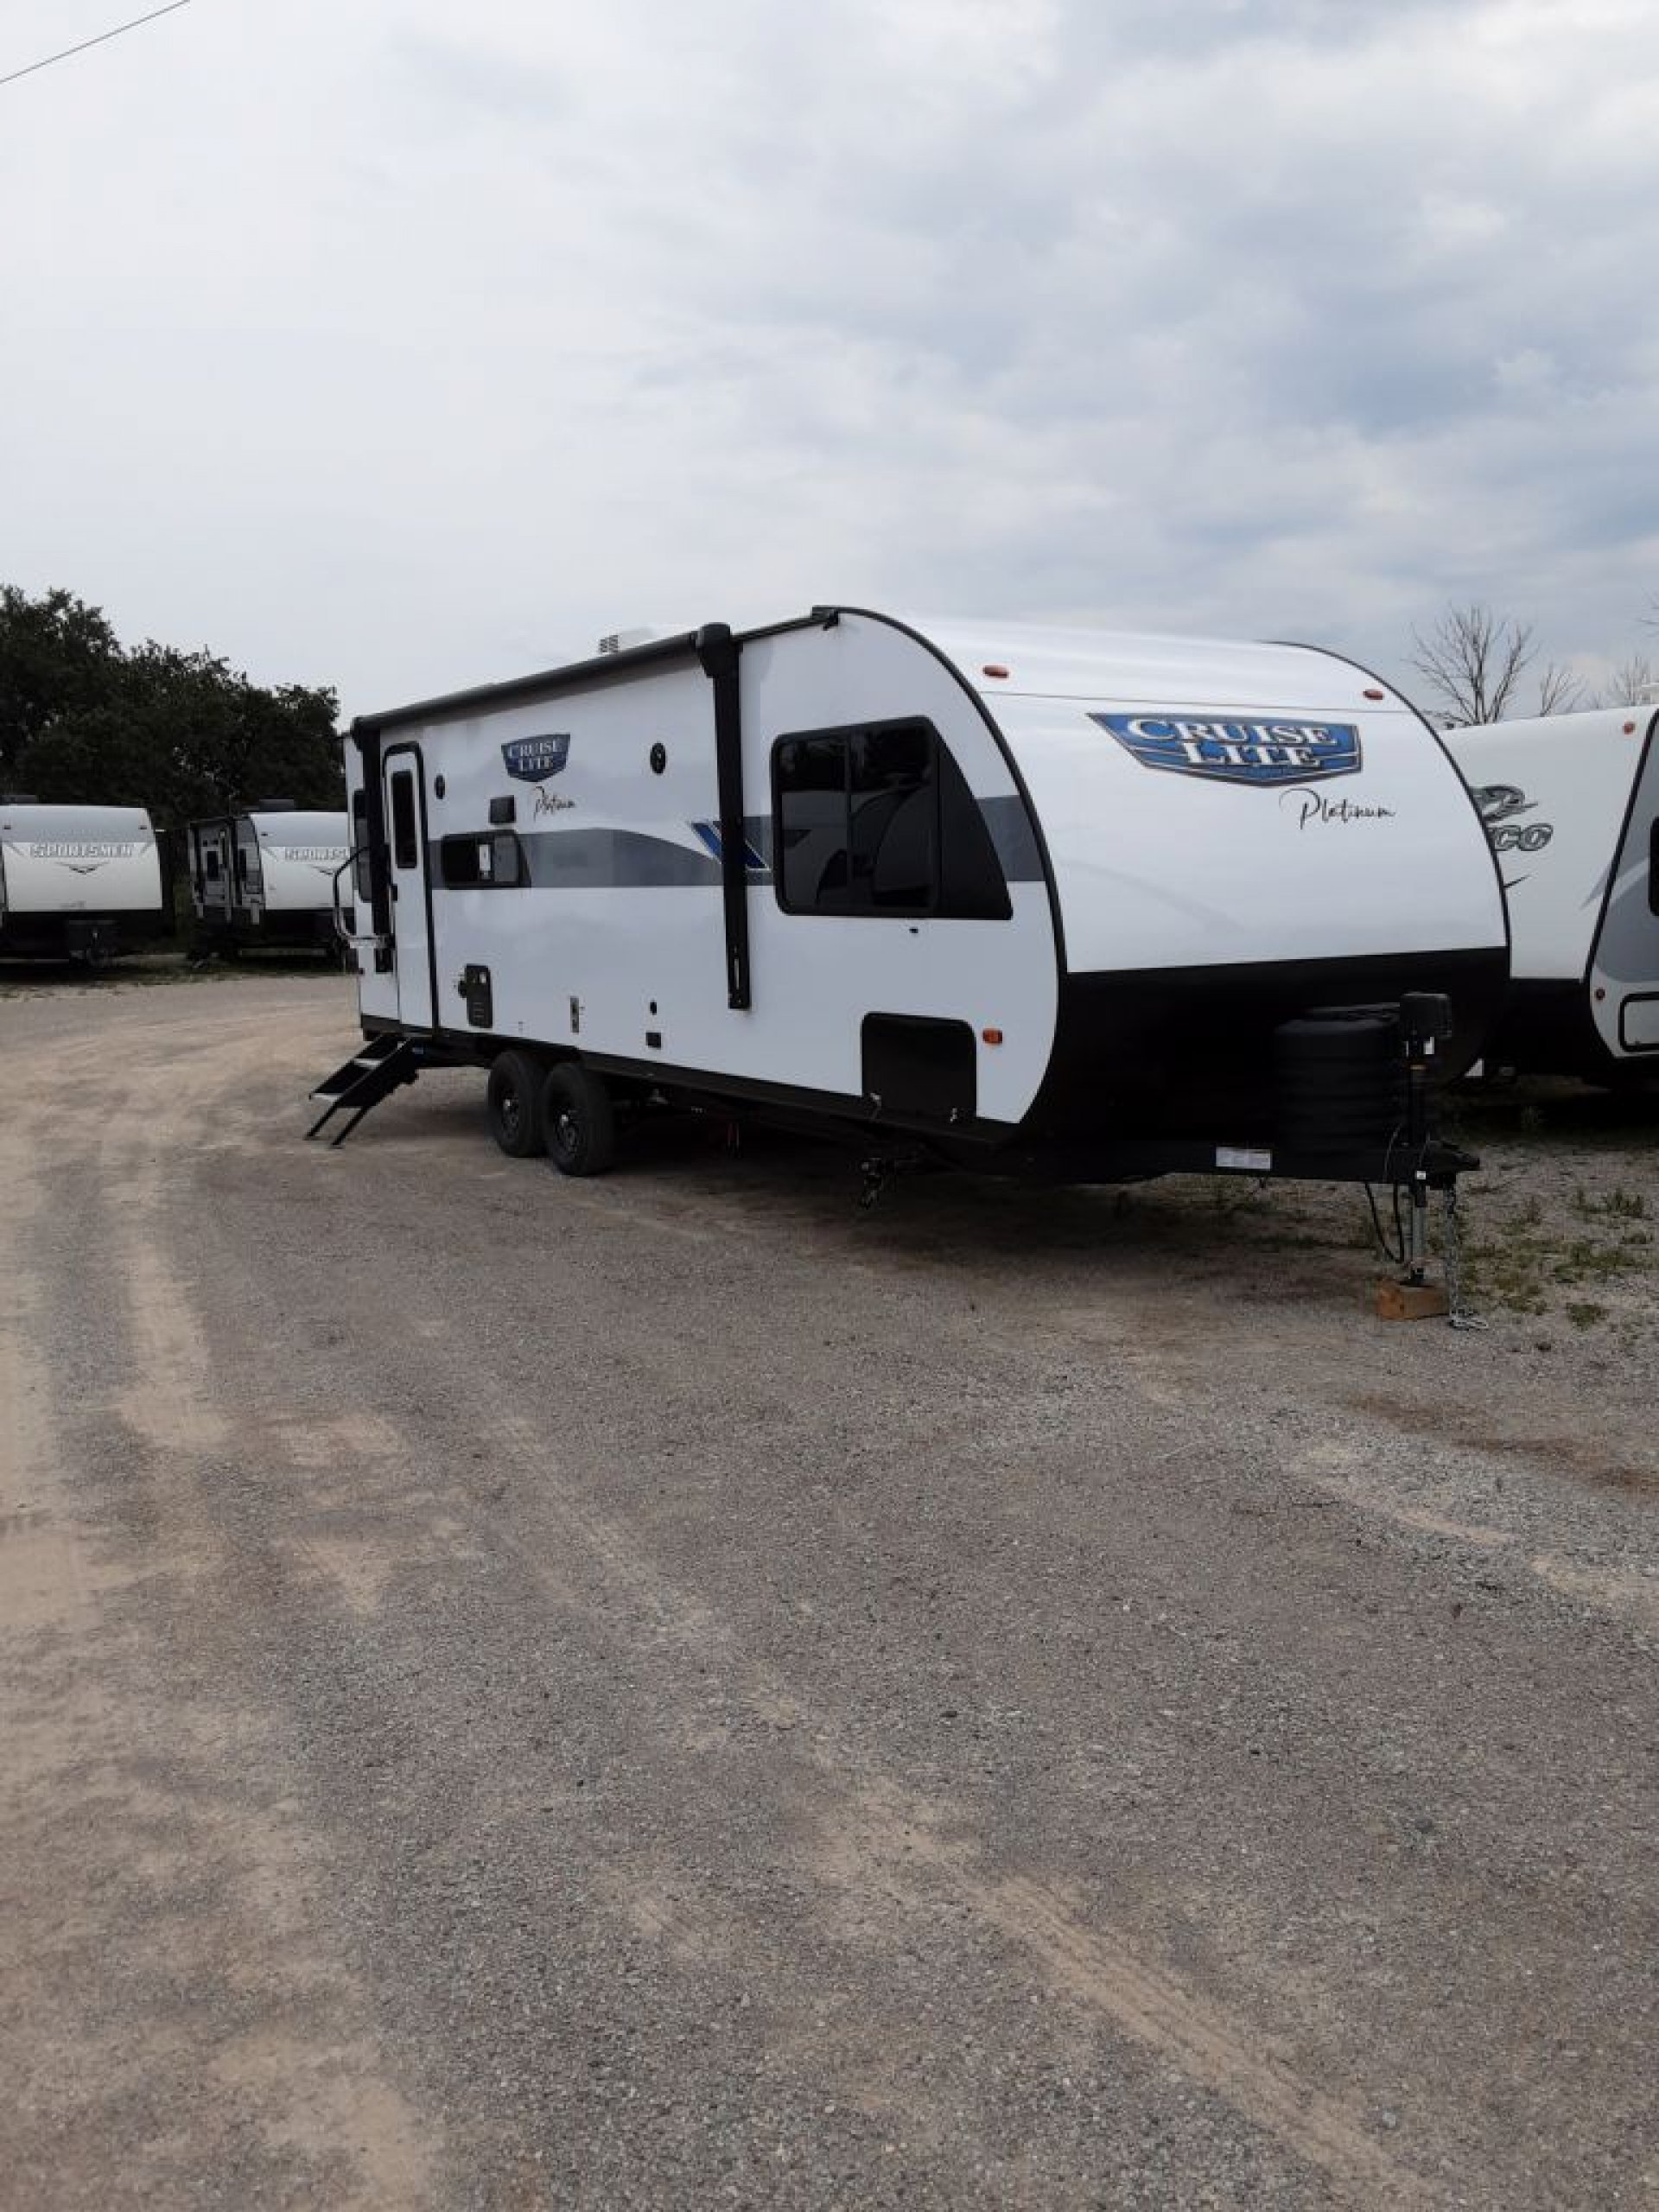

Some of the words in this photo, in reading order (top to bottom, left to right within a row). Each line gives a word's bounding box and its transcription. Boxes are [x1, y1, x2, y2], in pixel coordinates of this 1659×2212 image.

[1127, 718, 1338, 745] CRUISE
[1181, 741, 1321, 766] LITE
[1279, 787, 1395, 830] Platinum
